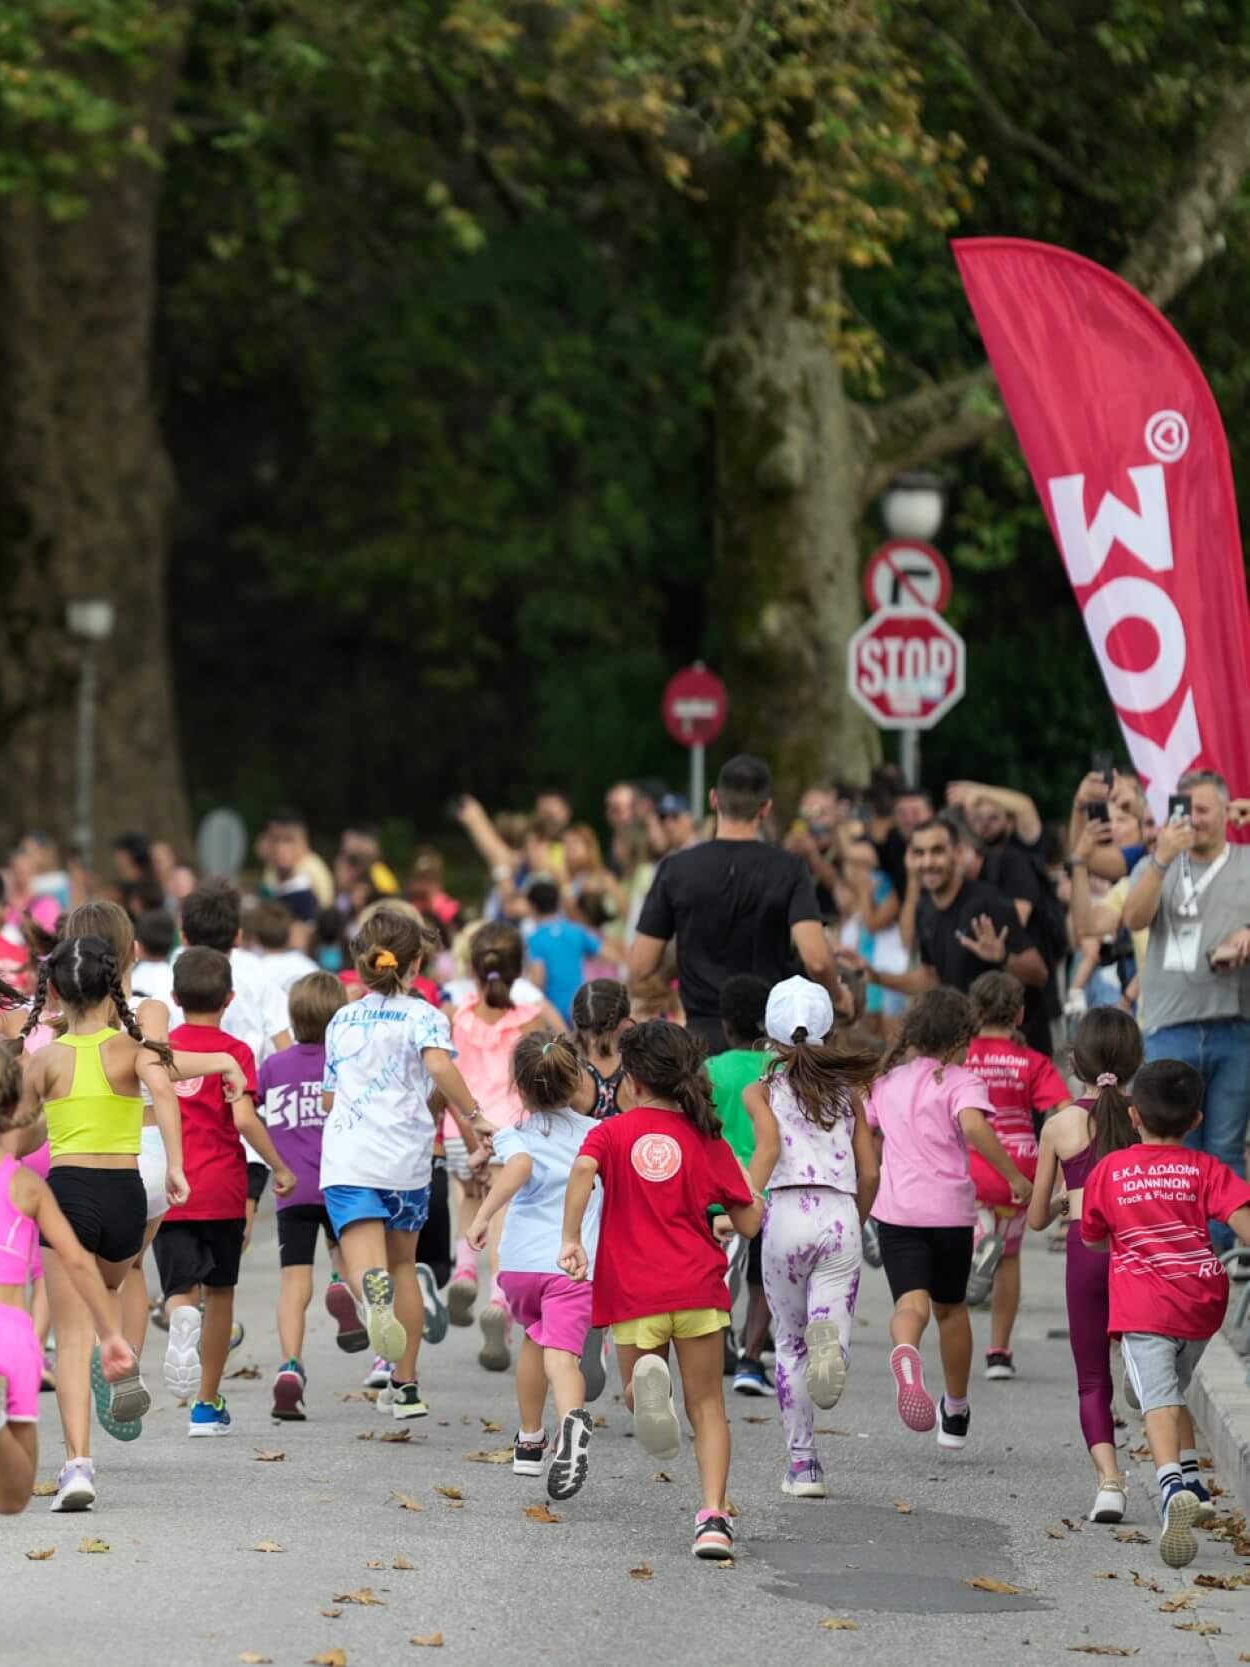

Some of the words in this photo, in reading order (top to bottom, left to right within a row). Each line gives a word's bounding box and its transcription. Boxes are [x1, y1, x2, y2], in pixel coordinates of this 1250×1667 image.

[860, 637, 953, 697] STOP
[300, 1081, 322, 1096] TR
[299, 1096, 329, 1117] RU
[1123, 1178, 1191, 1193] ΙΩΑΝΝΙΝΩΝ
[1117, 1193, 1143, 1206] Track
[1175, 1192, 1197, 1202] Club
